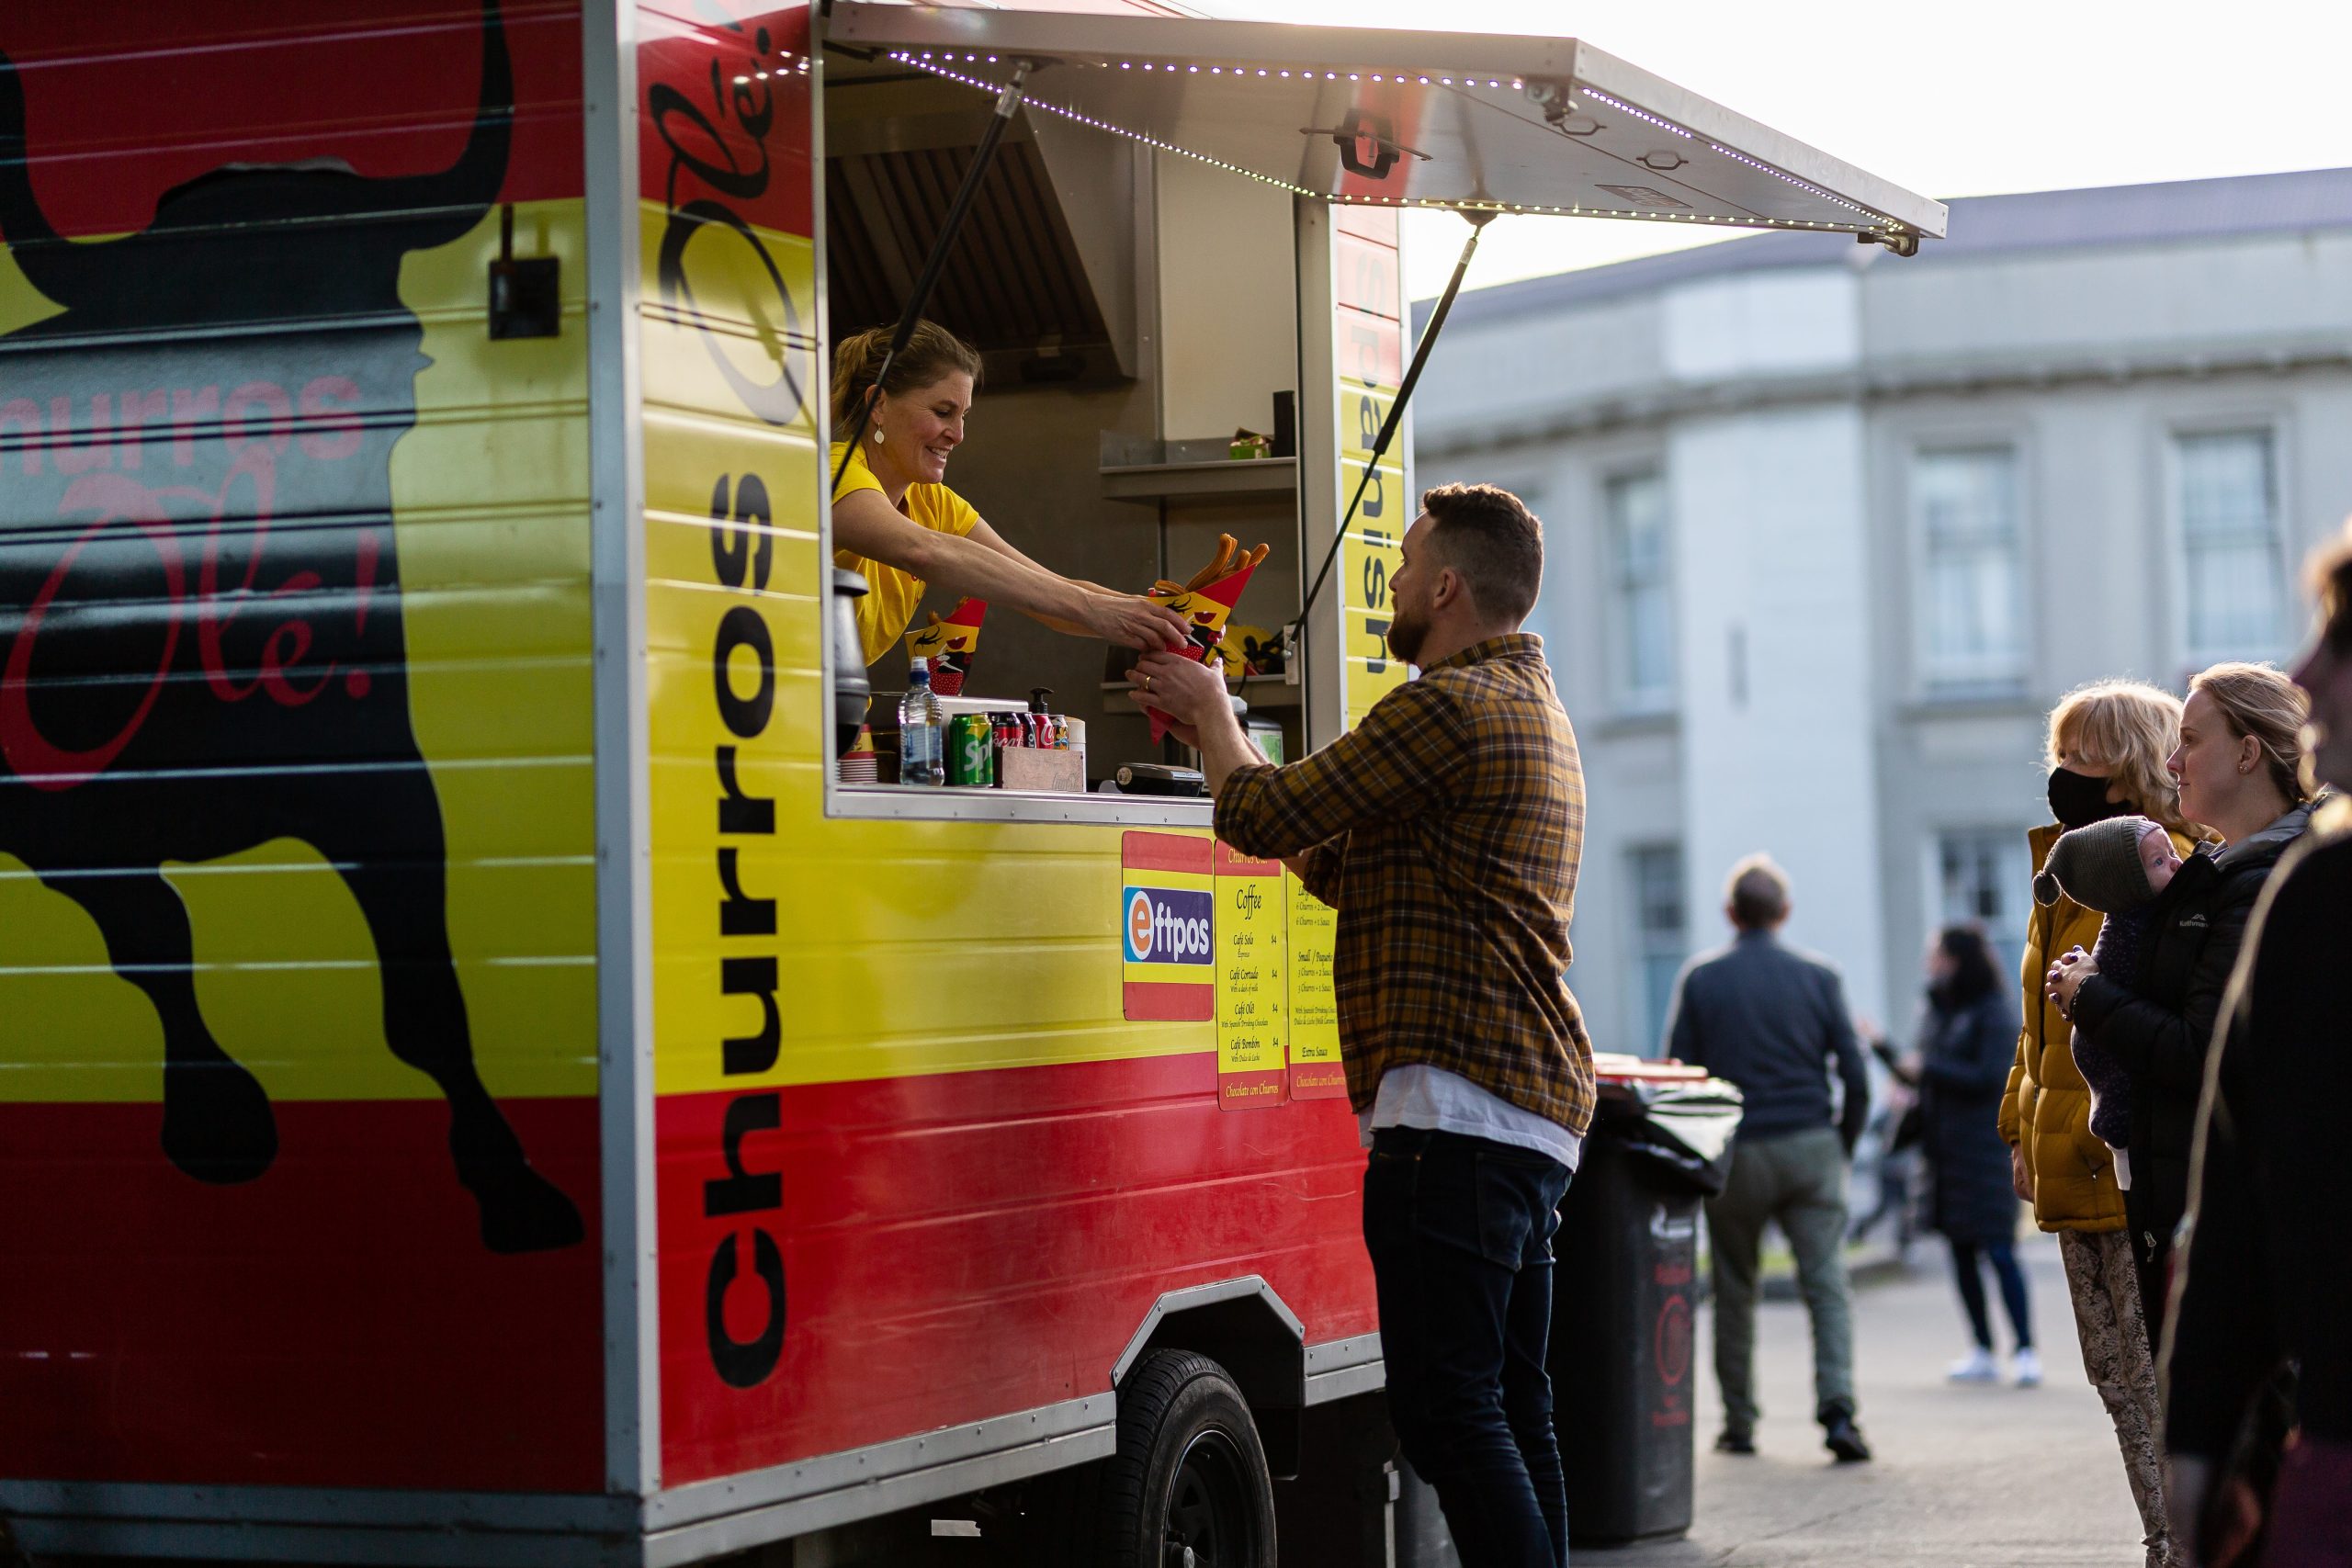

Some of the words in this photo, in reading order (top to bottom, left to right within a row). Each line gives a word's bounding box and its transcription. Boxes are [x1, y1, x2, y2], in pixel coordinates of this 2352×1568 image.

[1351, 252, 1393, 674] Spanish
[0, 443, 379, 792] Olé!
[1236, 884, 1262, 920] Coffee
[704, 472, 786, 1388] Churros
[1131, 898, 1210, 963] eftpos
[1233, 931, 1244, 951] Café
[1244, 931, 1254, 945] Solo
[1271, 933, 1277, 945] $4
[1297, 949, 1311, 963] Small
[1229, 966, 1240, 986] Café
[1240, 965, 1259, 981] Cortado
[1272, 968, 1278, 979] $4
[1234, 1001, 1245, 1020] Café
[1272, 1002, 1278, 1014] $4
[1230, 1036, 1241, 1055] Café
[1272, 1036, 1279, 1048] $4
[1302, 1047, 1316, 1057] Extra
[1317, 1046, 1328, 1057] Sauce
[1226, 1081, 1250, 1098] Chocolate
[1250, 1085, 1259, 1096] con
[1259, 1080, 1280, 1095] Churros
[1296, 1073, 1318, 1088] Chocolate
[1318, 1077, 1328, 1086] con
